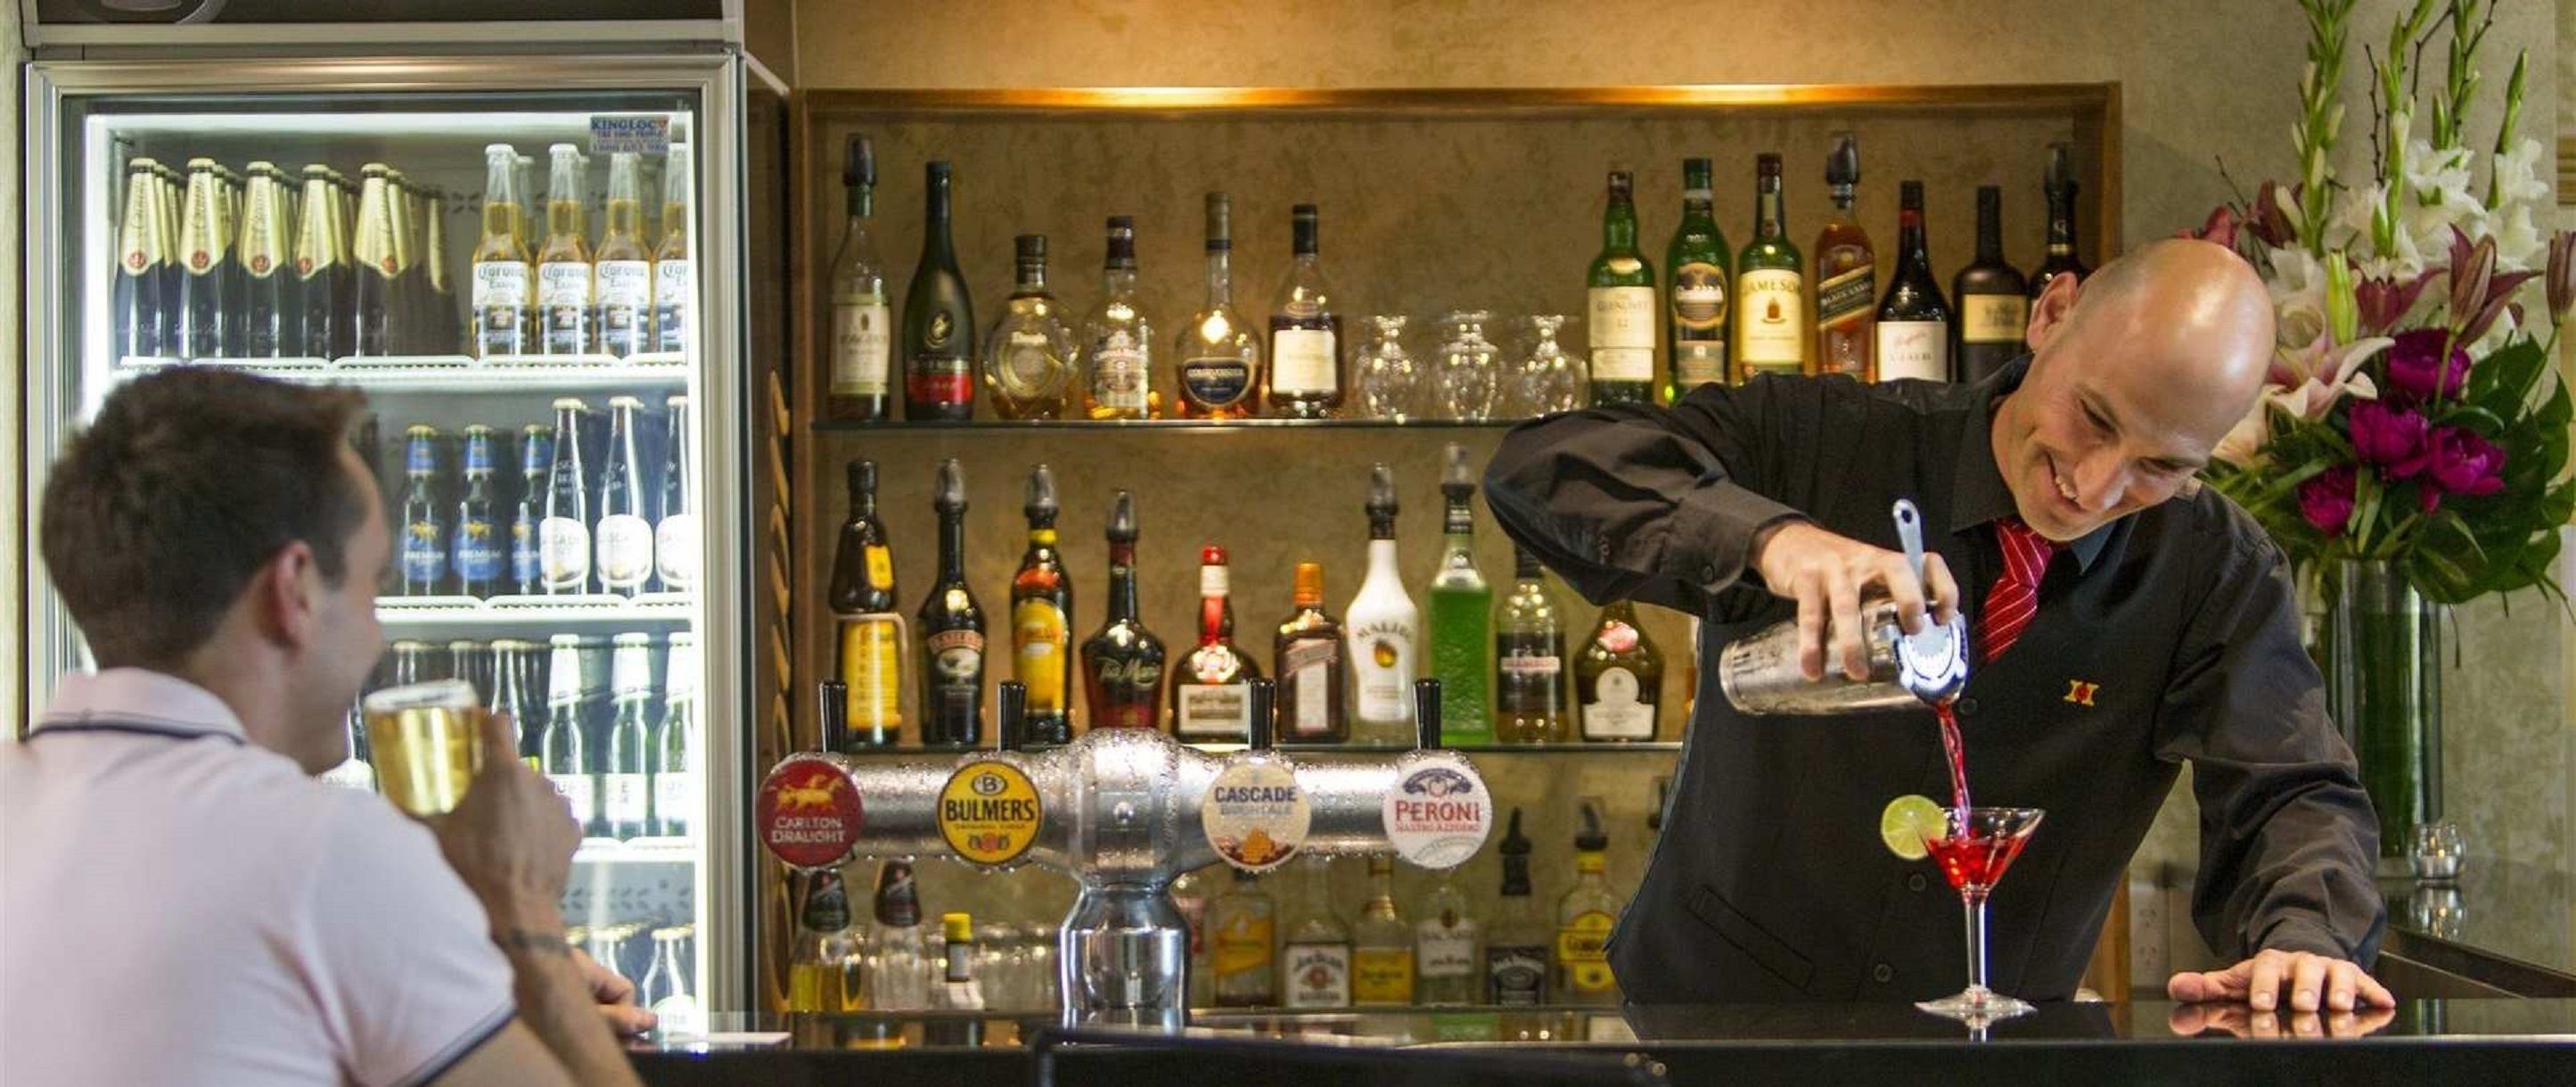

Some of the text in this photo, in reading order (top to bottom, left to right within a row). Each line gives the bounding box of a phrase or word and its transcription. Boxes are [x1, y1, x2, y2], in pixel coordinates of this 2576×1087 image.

[1215, 786, 1298, 803] CASCADE
[946, 799, 1035, 821] BULMERS
[1395, 800, 1481, 821] PERONI
[775, 817, 842, 830] CARLTON
[772, 830, 845, 844] DRAUGHT
